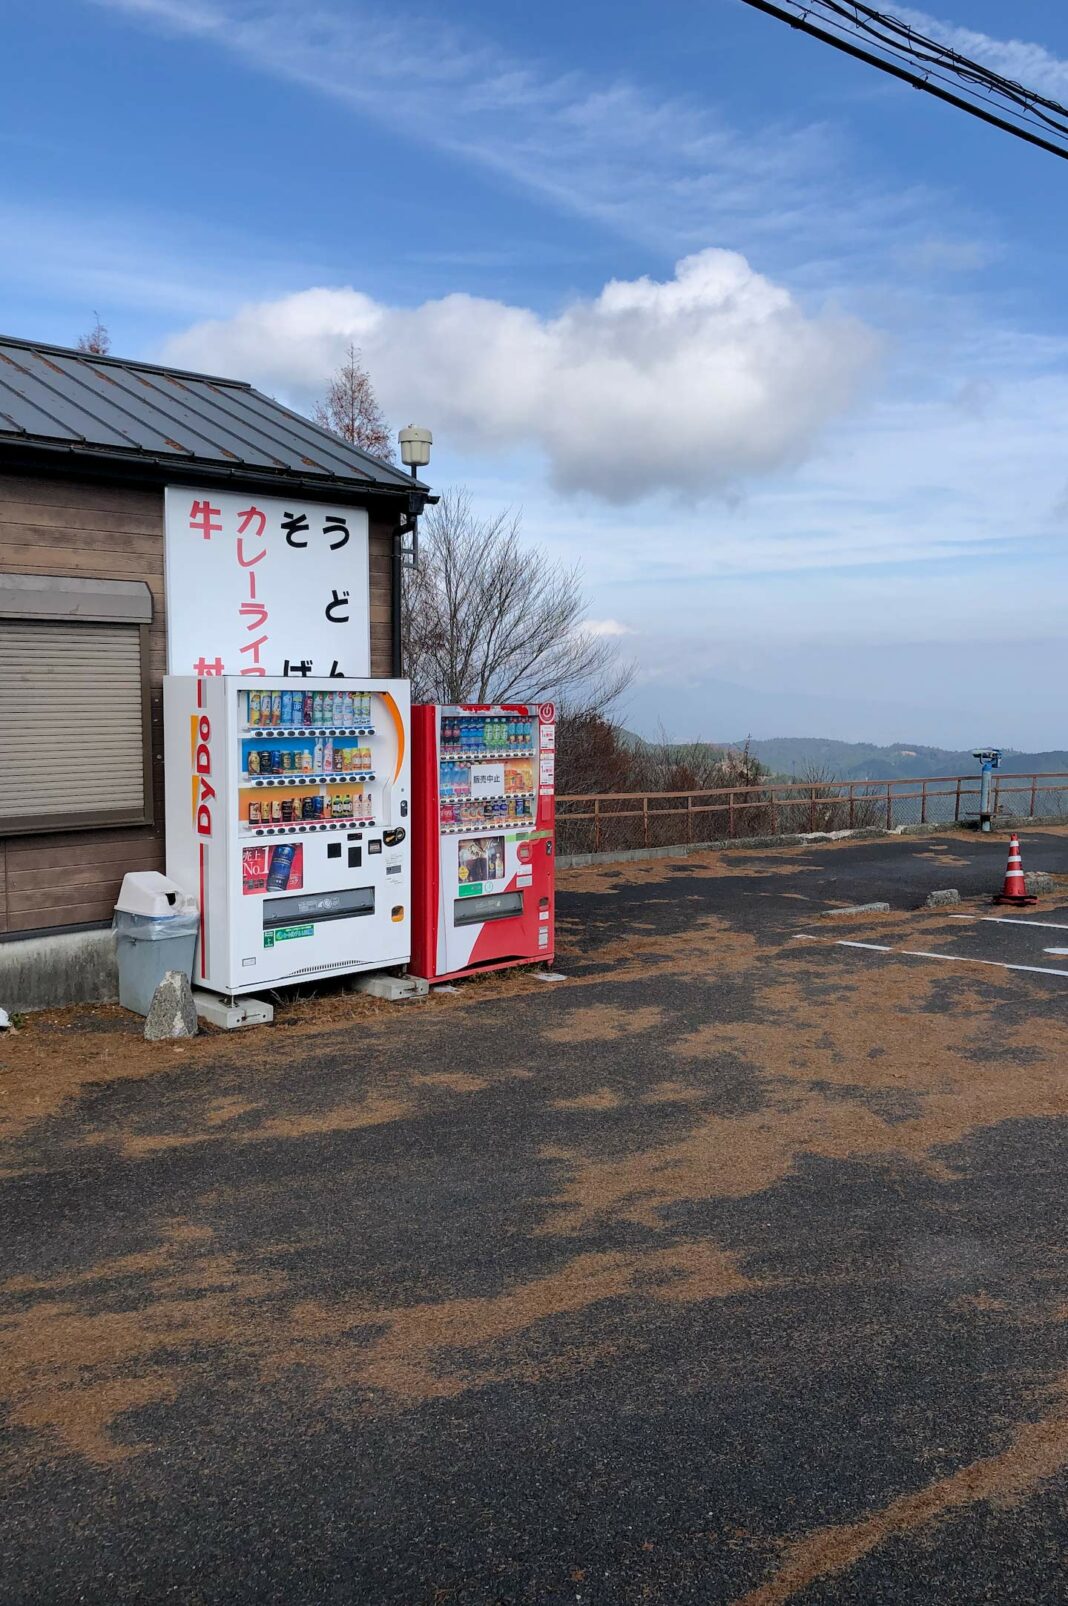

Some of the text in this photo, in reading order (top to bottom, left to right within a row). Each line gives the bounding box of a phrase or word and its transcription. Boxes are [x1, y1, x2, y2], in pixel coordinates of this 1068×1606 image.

[237, 506, 269, 677] カレーライ
[473, 774, 501, 784] 販売中止
